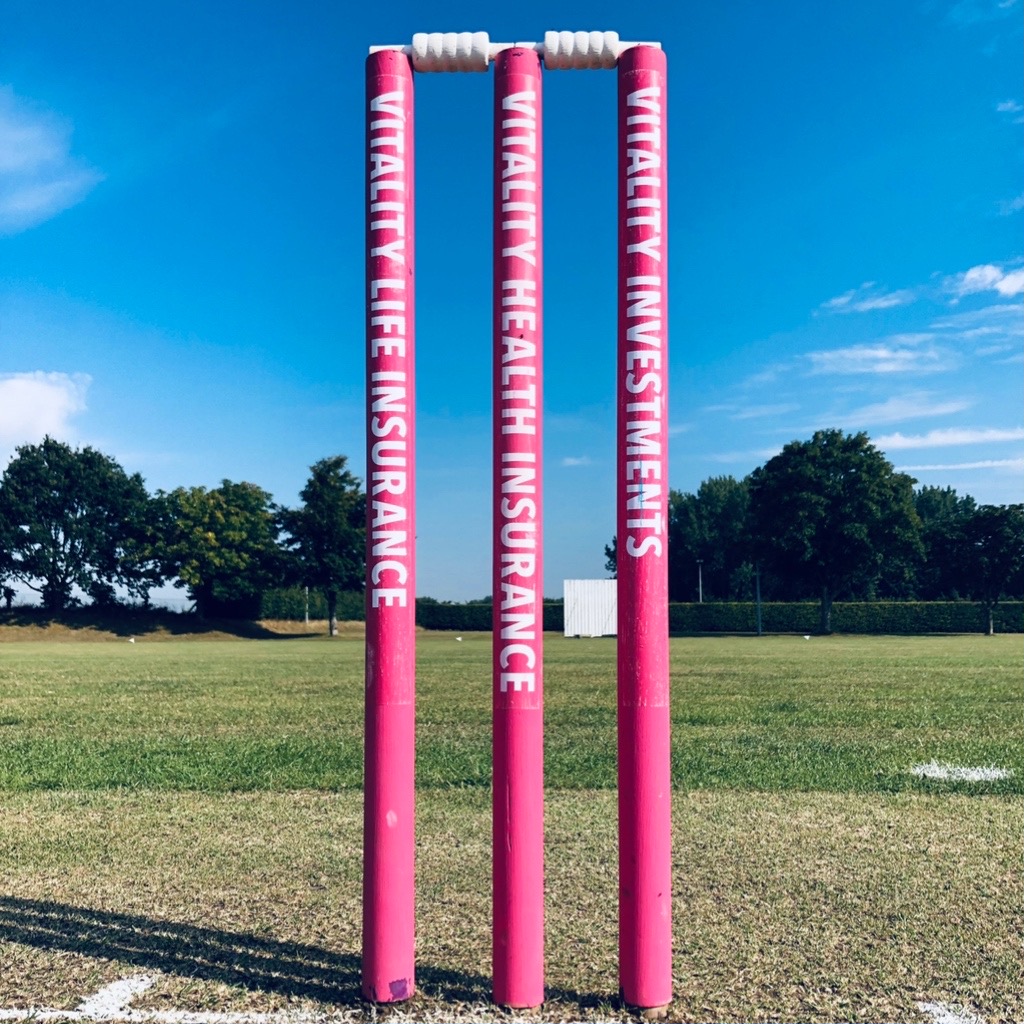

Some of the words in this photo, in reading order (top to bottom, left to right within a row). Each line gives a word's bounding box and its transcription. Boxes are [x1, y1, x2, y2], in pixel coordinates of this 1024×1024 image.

[370, 89, 406, 266] VITALITY
[501, 90, 537, 268] VITALITY
[626, 85, 662, 263] VITALITY
[370, 278, 406, 359] LIFE
[501, 279, 537, 436] HEALTH
[370, 370, 408, 609] INSURANCE
[625, 275, 663, 559] INVESTMENTS
[500, 451, 537, 694] INSURANCE
